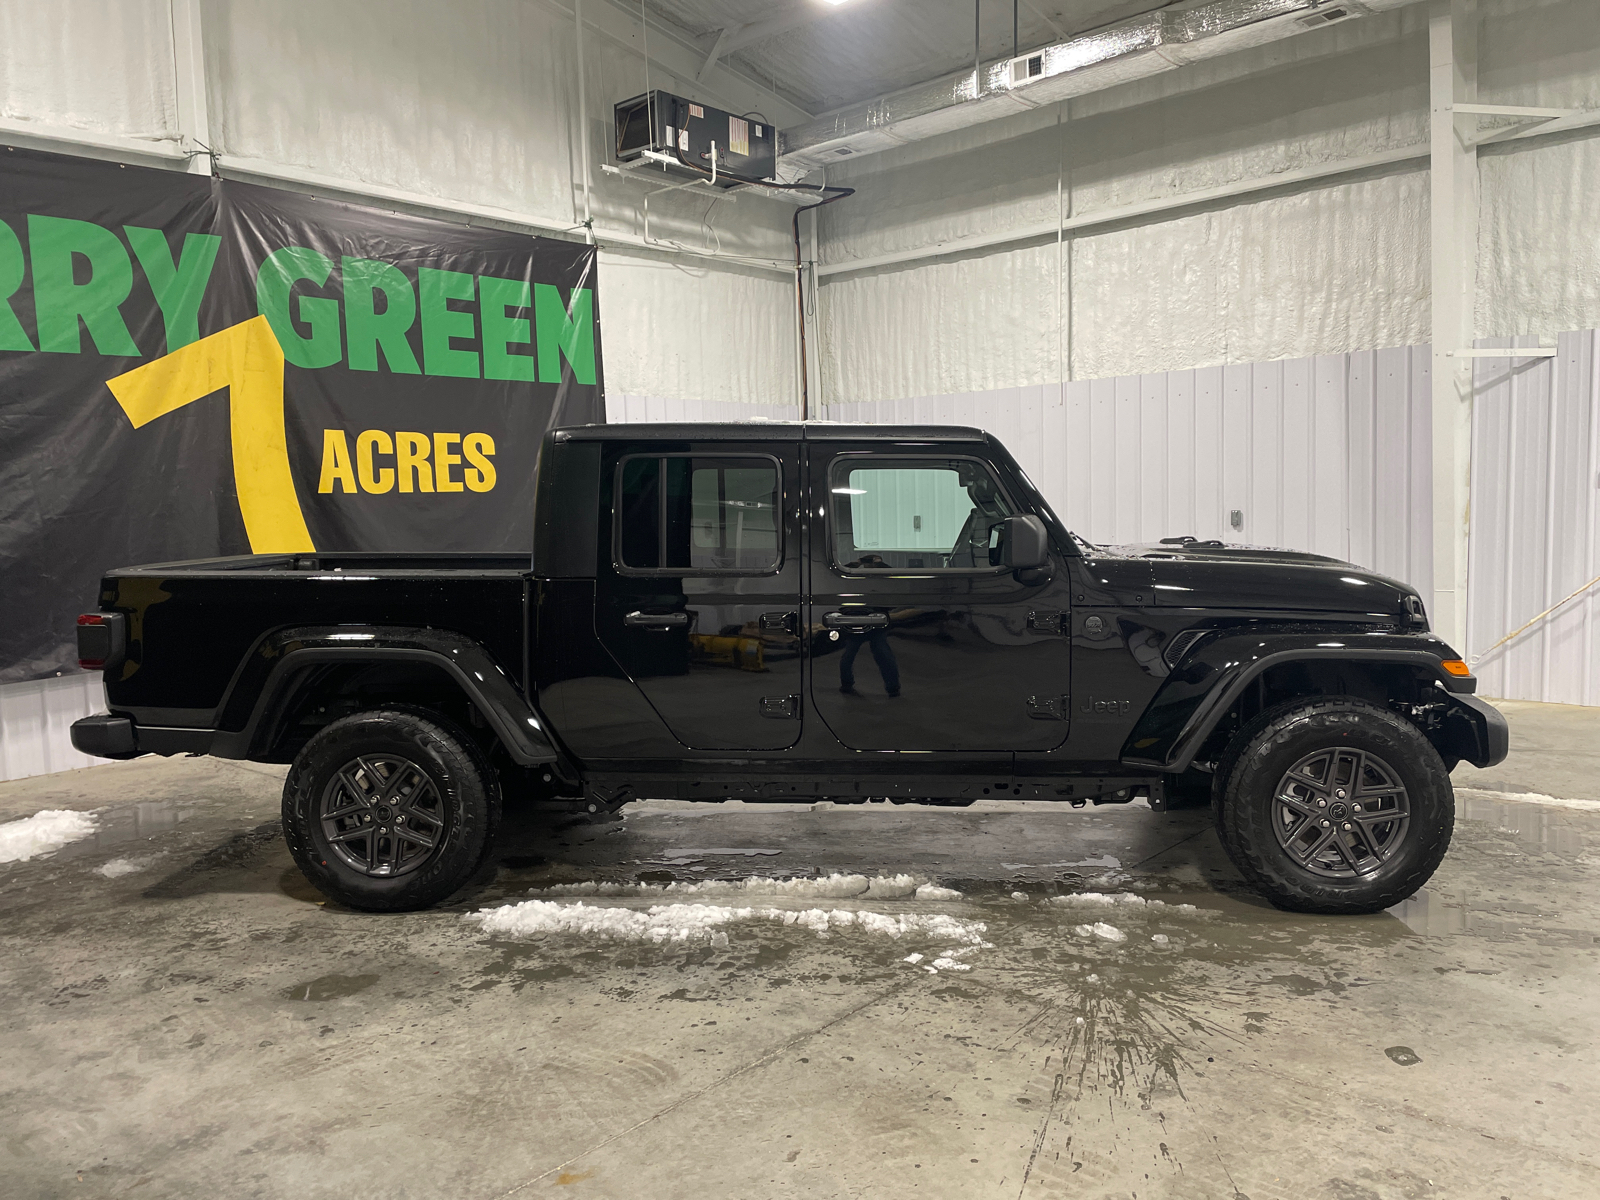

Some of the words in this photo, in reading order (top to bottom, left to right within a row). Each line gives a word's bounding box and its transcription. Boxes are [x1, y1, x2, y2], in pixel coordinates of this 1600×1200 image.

[256, 247, 597, 386] GREEN
[106, 314, 317, 554] 7
[318, 429, 497, 494] ACRES
[1080, 695, 1131, 717] Jeep
